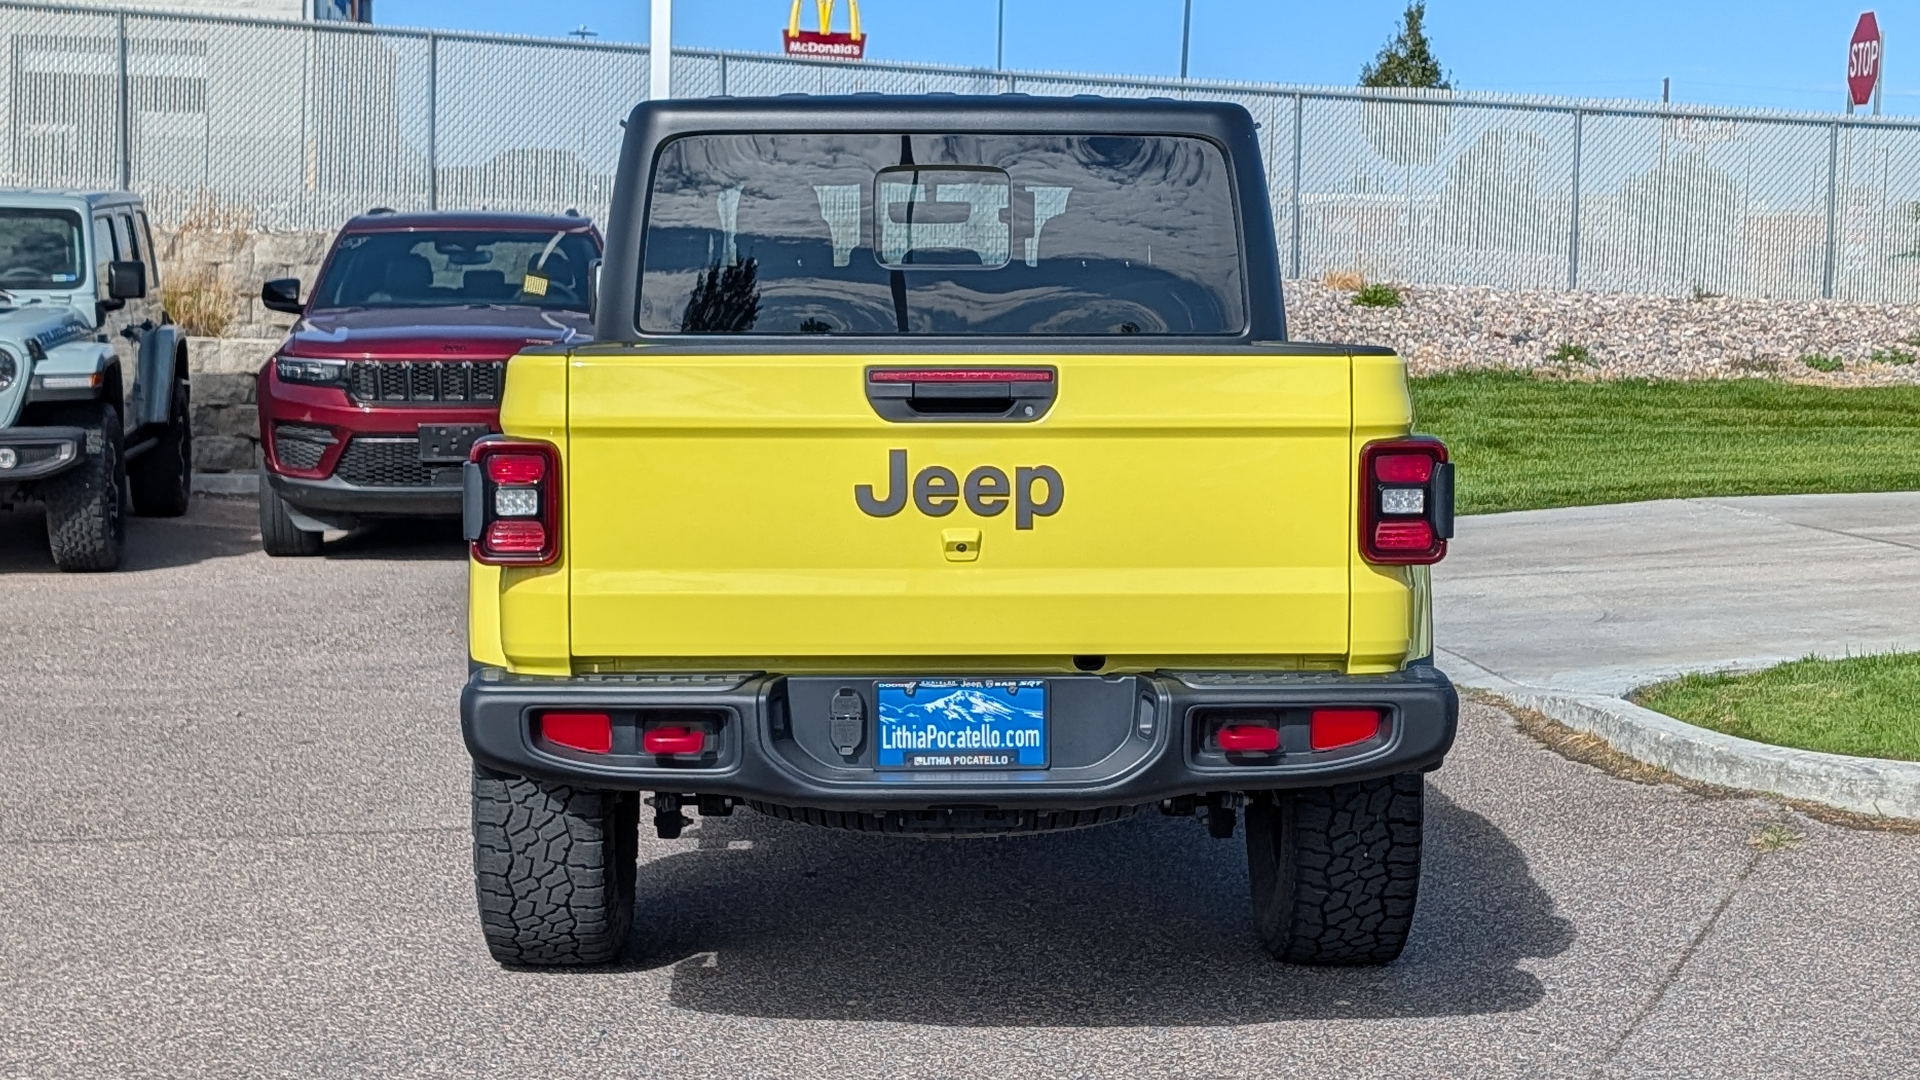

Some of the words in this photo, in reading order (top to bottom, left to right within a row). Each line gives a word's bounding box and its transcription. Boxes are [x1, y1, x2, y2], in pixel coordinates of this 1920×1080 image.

[789, 41, 860, 55] McDonald's
[1849, 40, 1879, 78] STOP
[854, 448, 1065, 531] Jeep
[882, 723, 1040, 749] LithiaPocatello.com
[923, 756, 951, 766] LITHIA
[953, 756, 1008, 766] POCATELLO
